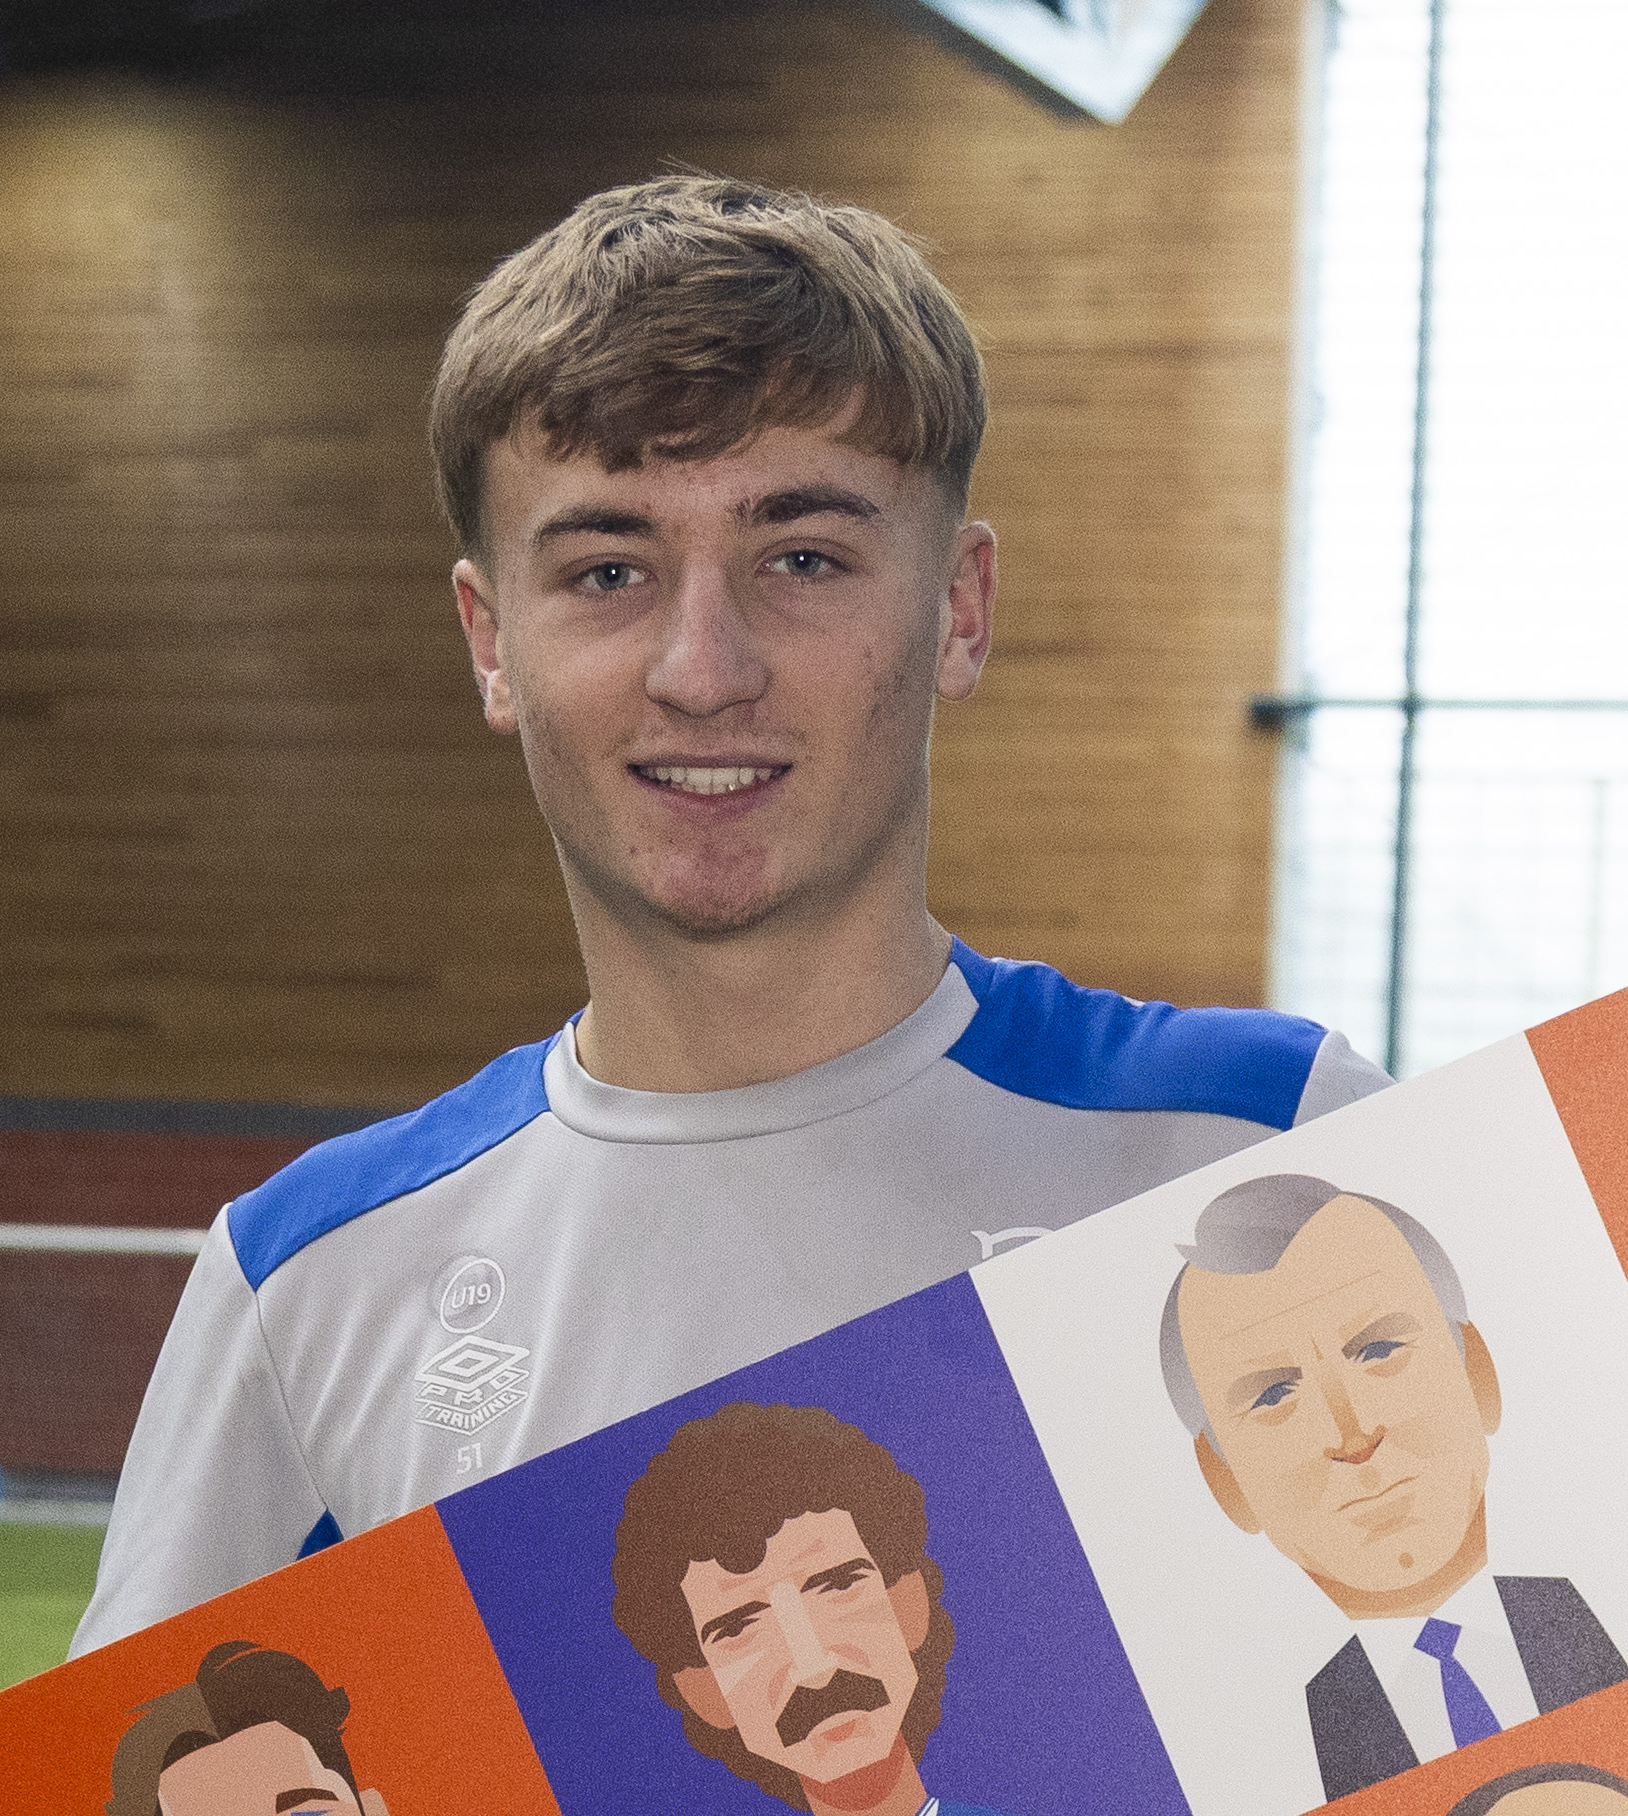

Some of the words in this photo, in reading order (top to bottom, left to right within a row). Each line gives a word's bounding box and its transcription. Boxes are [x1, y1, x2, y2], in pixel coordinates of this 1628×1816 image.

[450, 1282, 492, 1310] U19
[421, 1369, 521, 1406] PRO
[425, 1391, 518, 1430] TRAINING
[456, 1442, 483, 1475] 51
